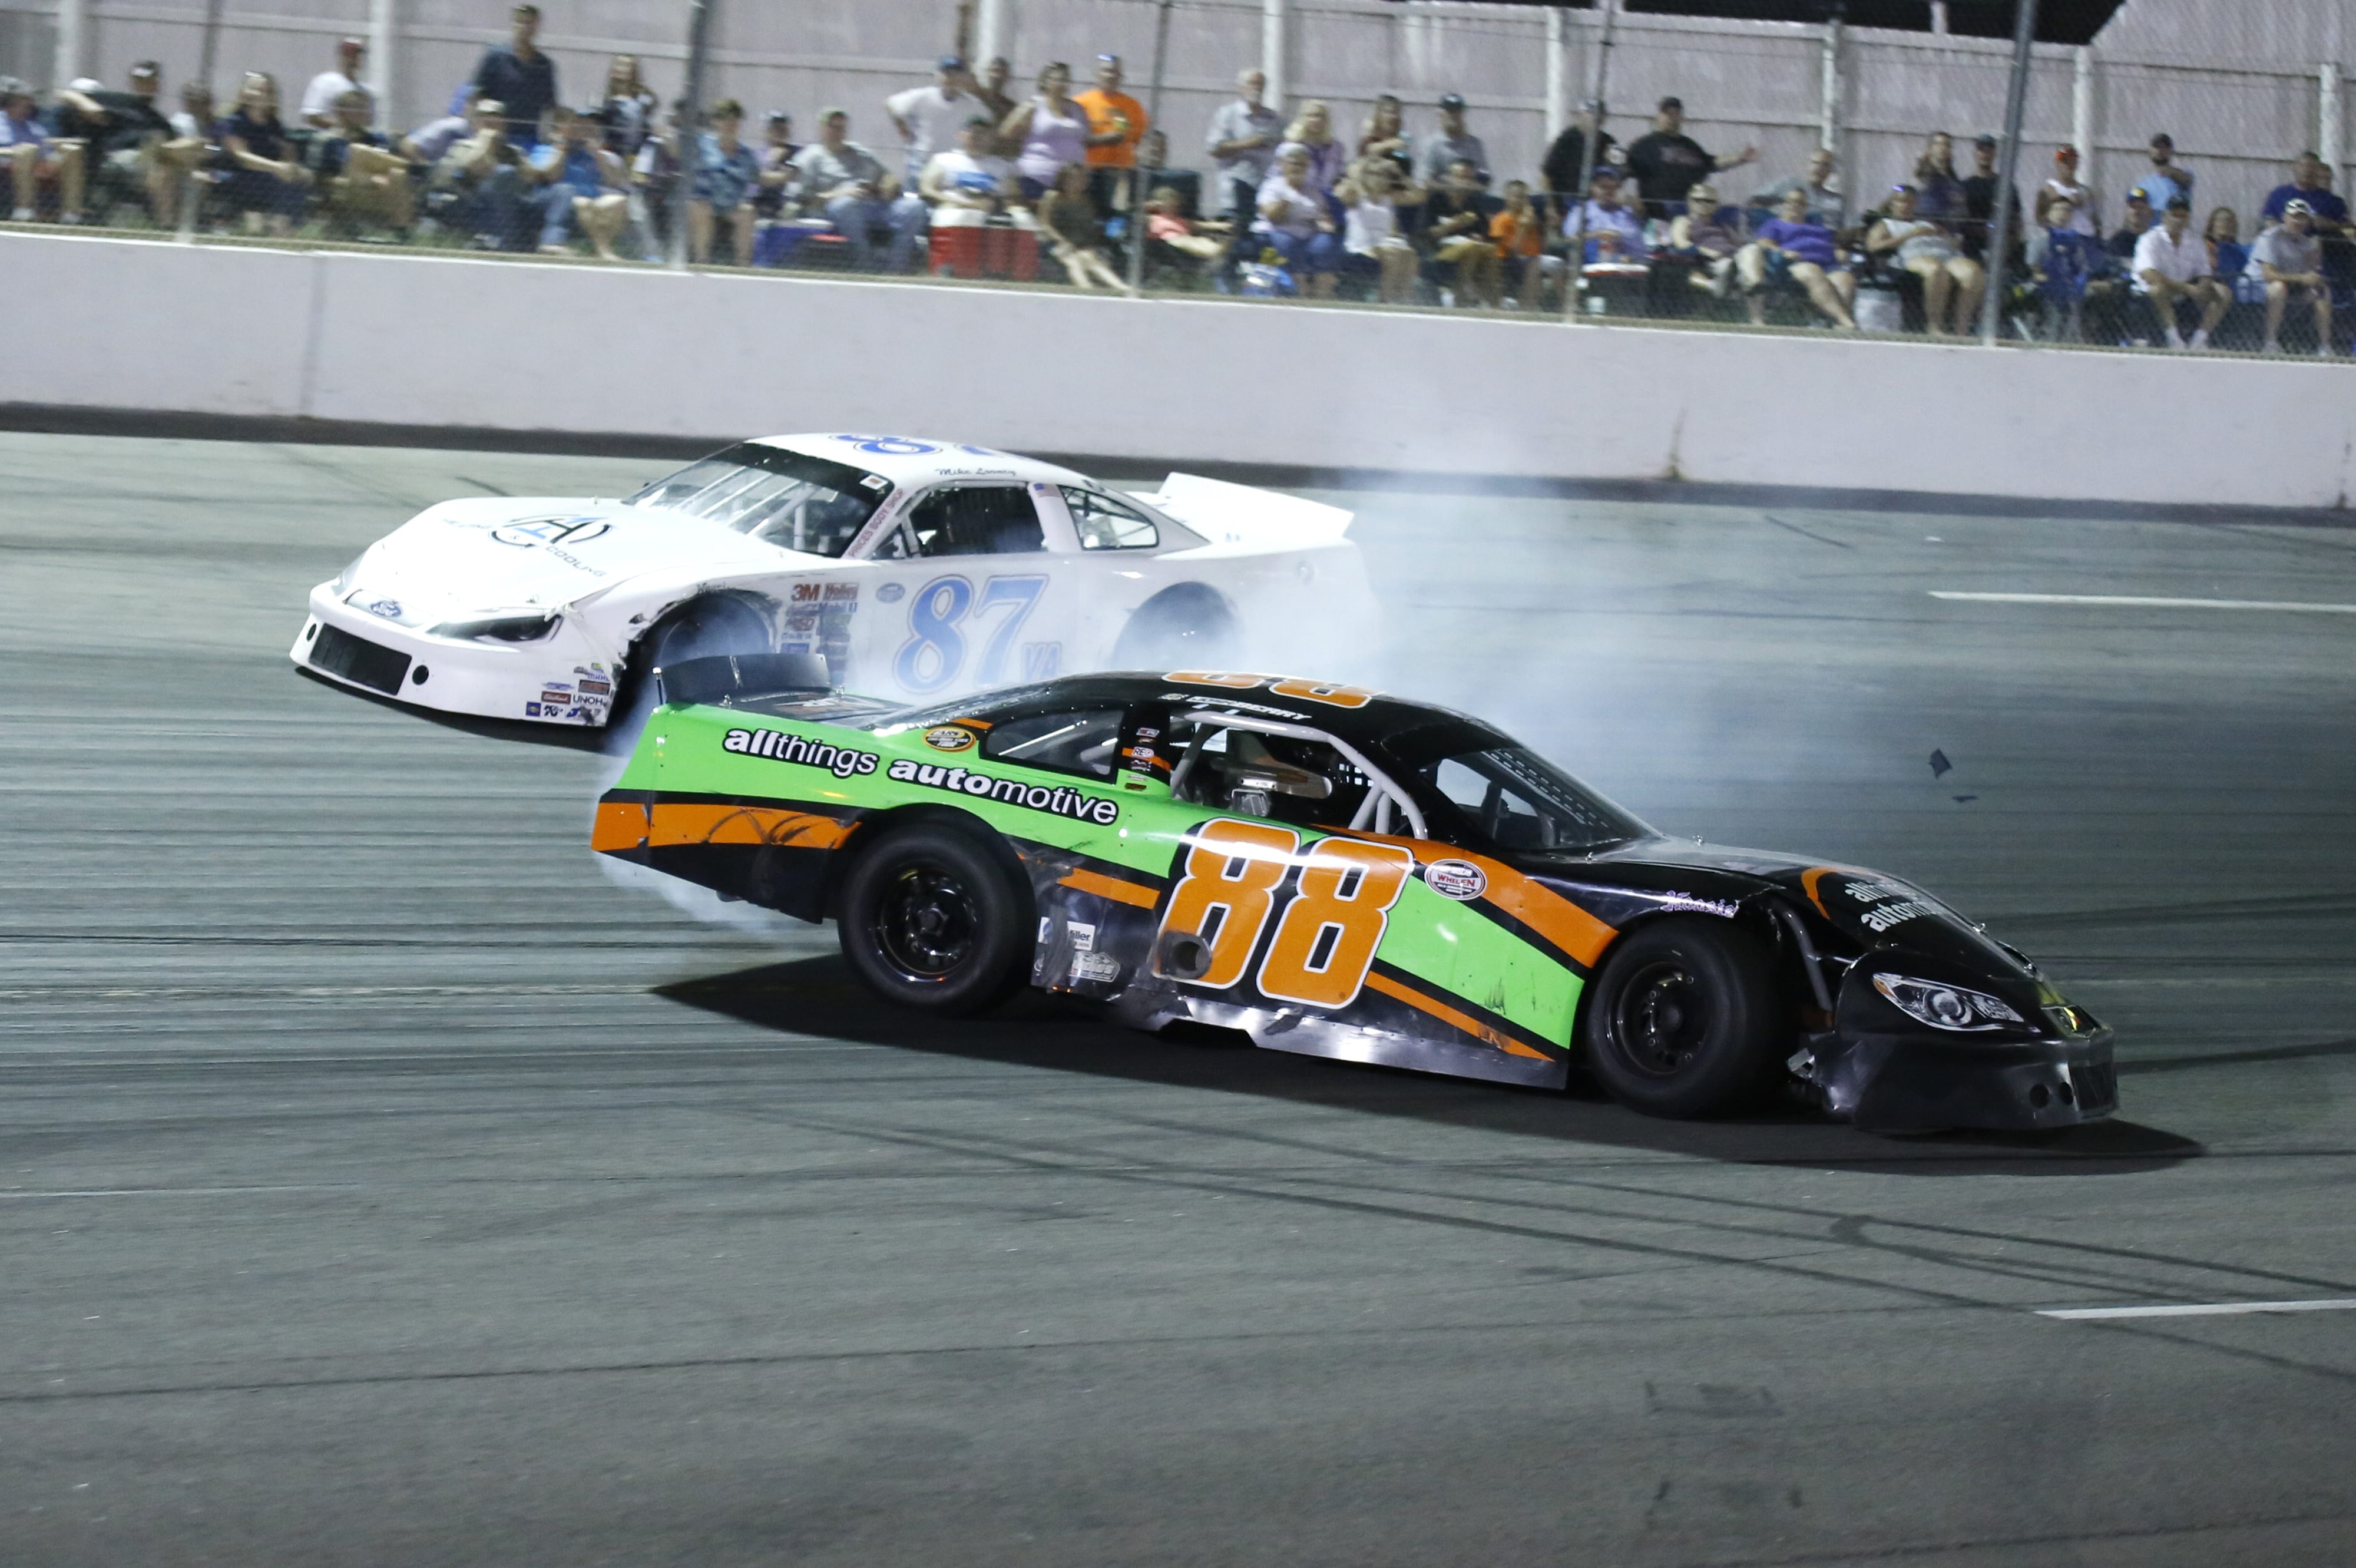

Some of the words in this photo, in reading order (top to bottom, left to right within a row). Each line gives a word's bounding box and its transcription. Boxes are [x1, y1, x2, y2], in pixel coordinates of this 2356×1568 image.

[545, 546, 606, 577] COOLING
[790, 583, 820, 601] 3M
[892, 574, 1050, 696] 87
[1021, 641, 1061, 681] VA
[573, 694, 603, 706] UNOH
[724, 729, 878, 777] allthings
[888, 759, 1117, 824] automotive
[1438, 874, 1475, 887] WHELEN
[1152, 817, 1415, 1009] 88
